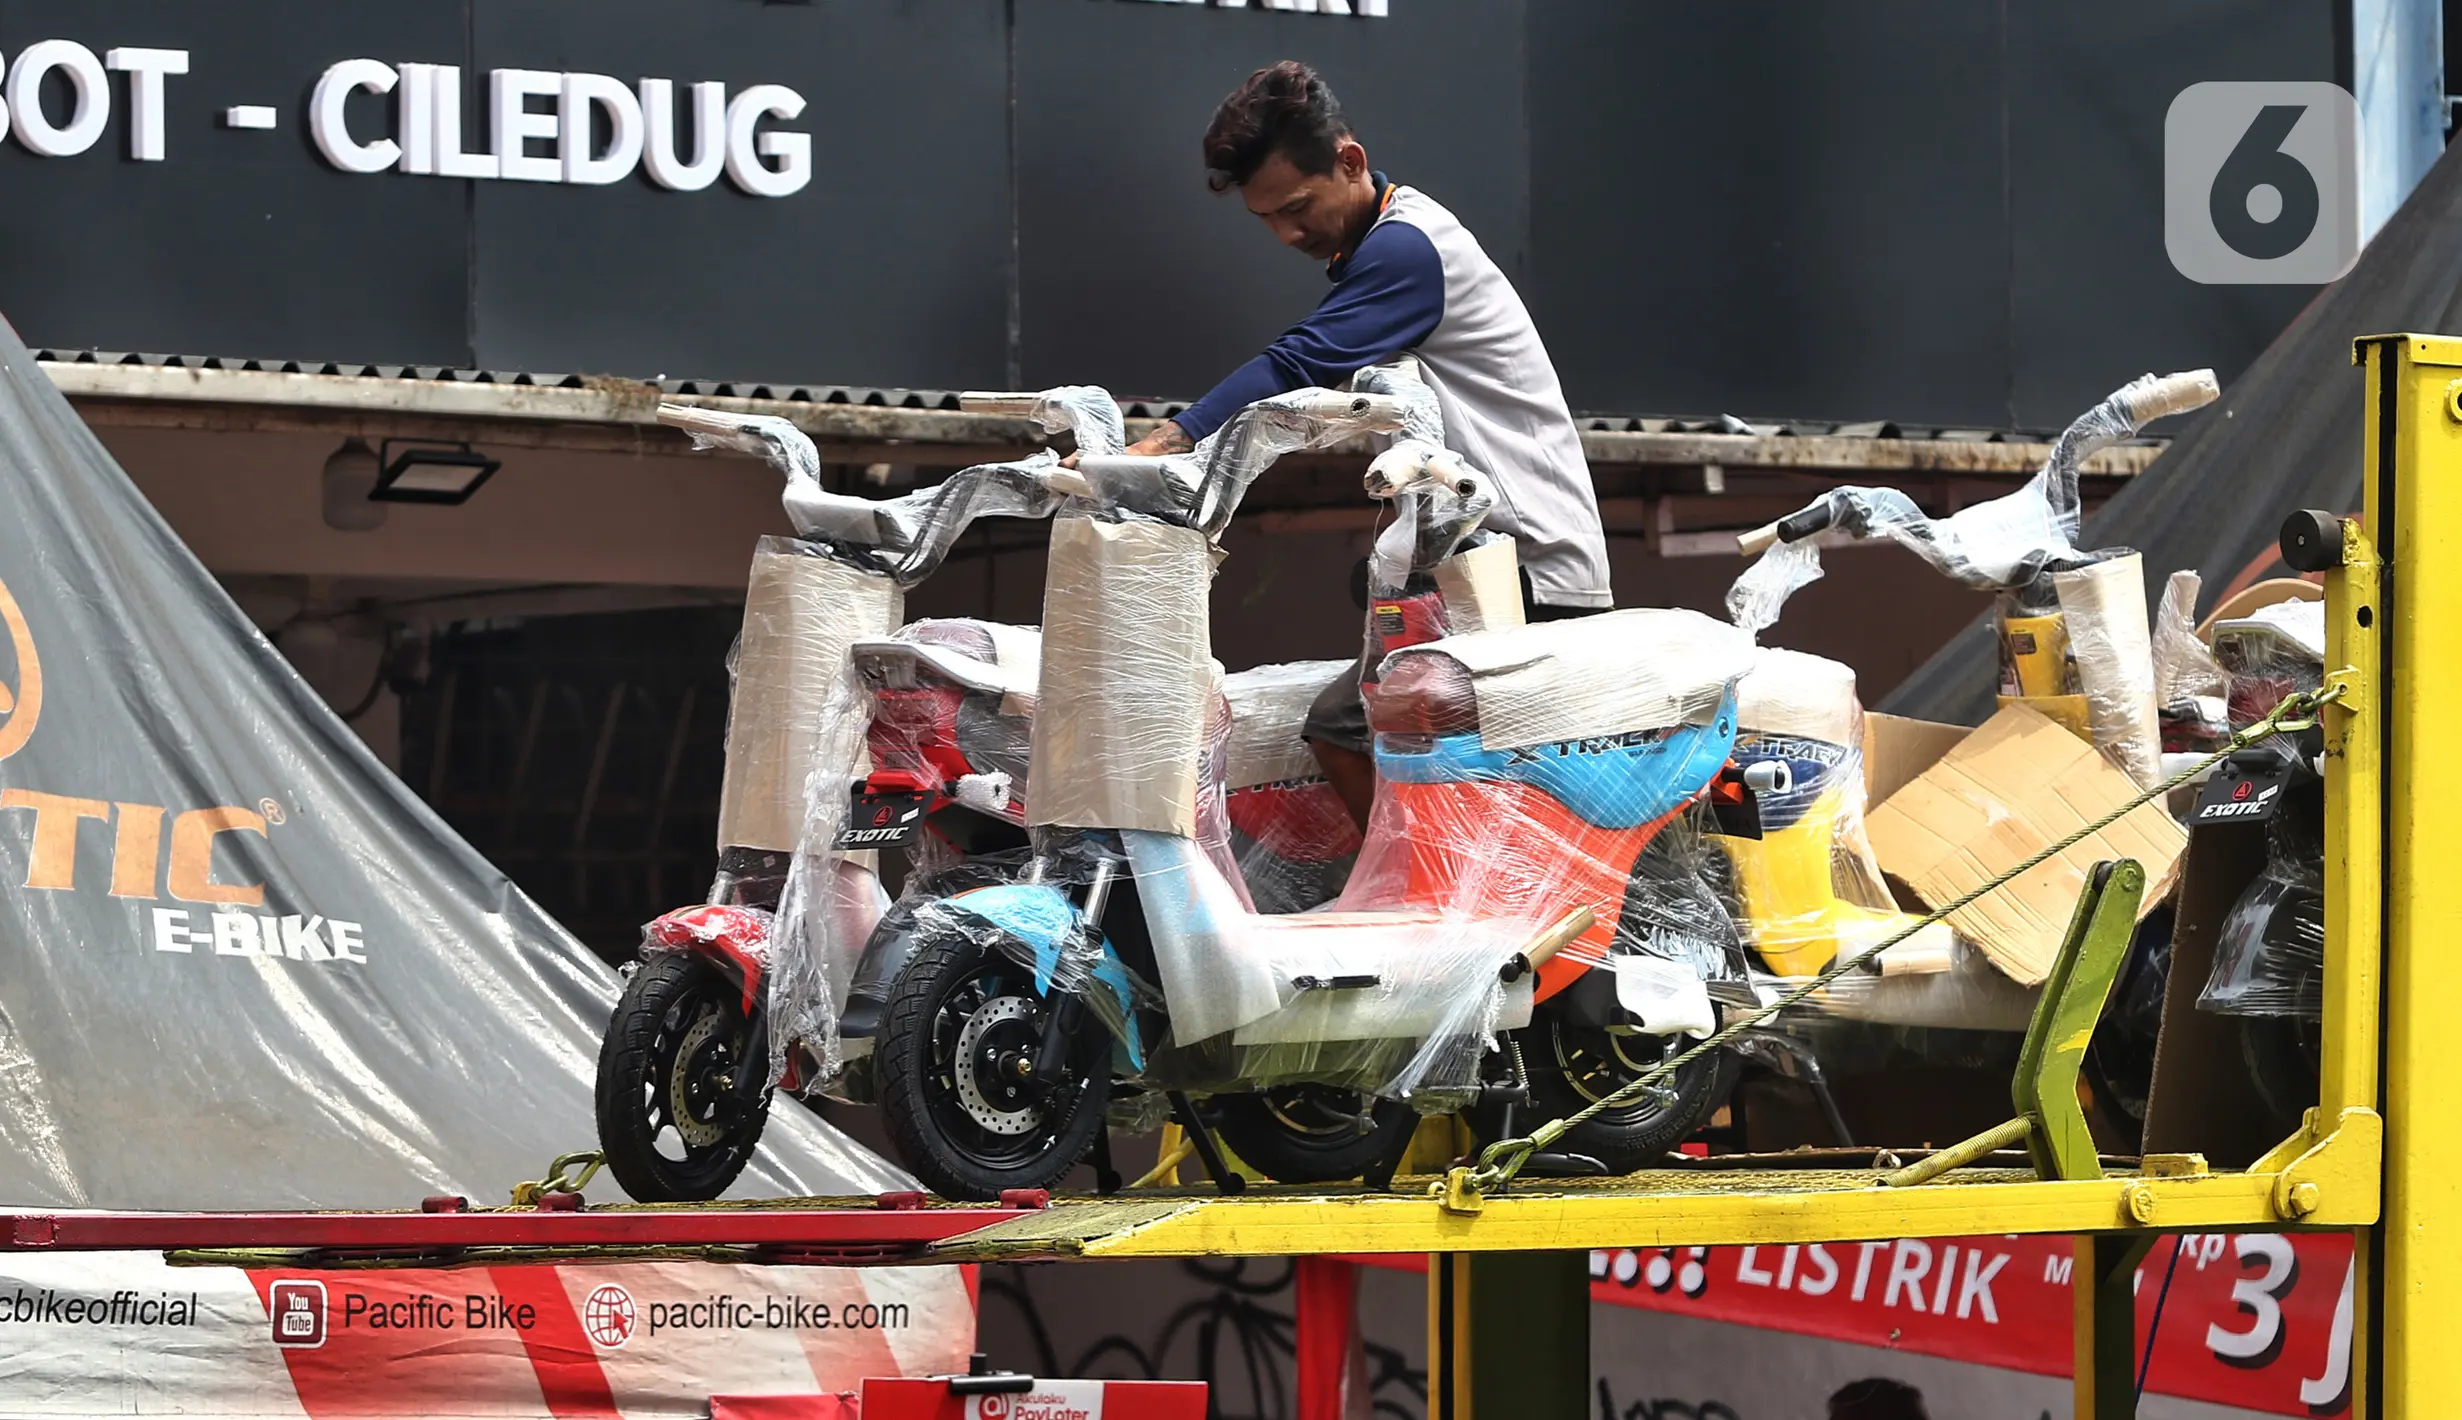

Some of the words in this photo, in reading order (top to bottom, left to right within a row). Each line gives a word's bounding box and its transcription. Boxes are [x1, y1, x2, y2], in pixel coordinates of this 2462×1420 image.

[0, 38, 189, 162] OT
[310, 58, 812, 197] CILEDUG
[2199, 800, 2269, 818] EXOTIC
[840, 826, 910, 843] EXOTIC
[152, 907, 367, 964] E-BIKE
[288, 1291, 309, 1311] You
[1736, 1239, 2011, 1324] LISTRIK
[2205, 1233, 2294, 1358] 3
[286, 1314, 312, 1333] Tube
[344, 1293, 455, 1330] Pacific
[465, 1294, 536, 1330] Bike
[649, 1294, 909, 1337] pacific-bike.com
